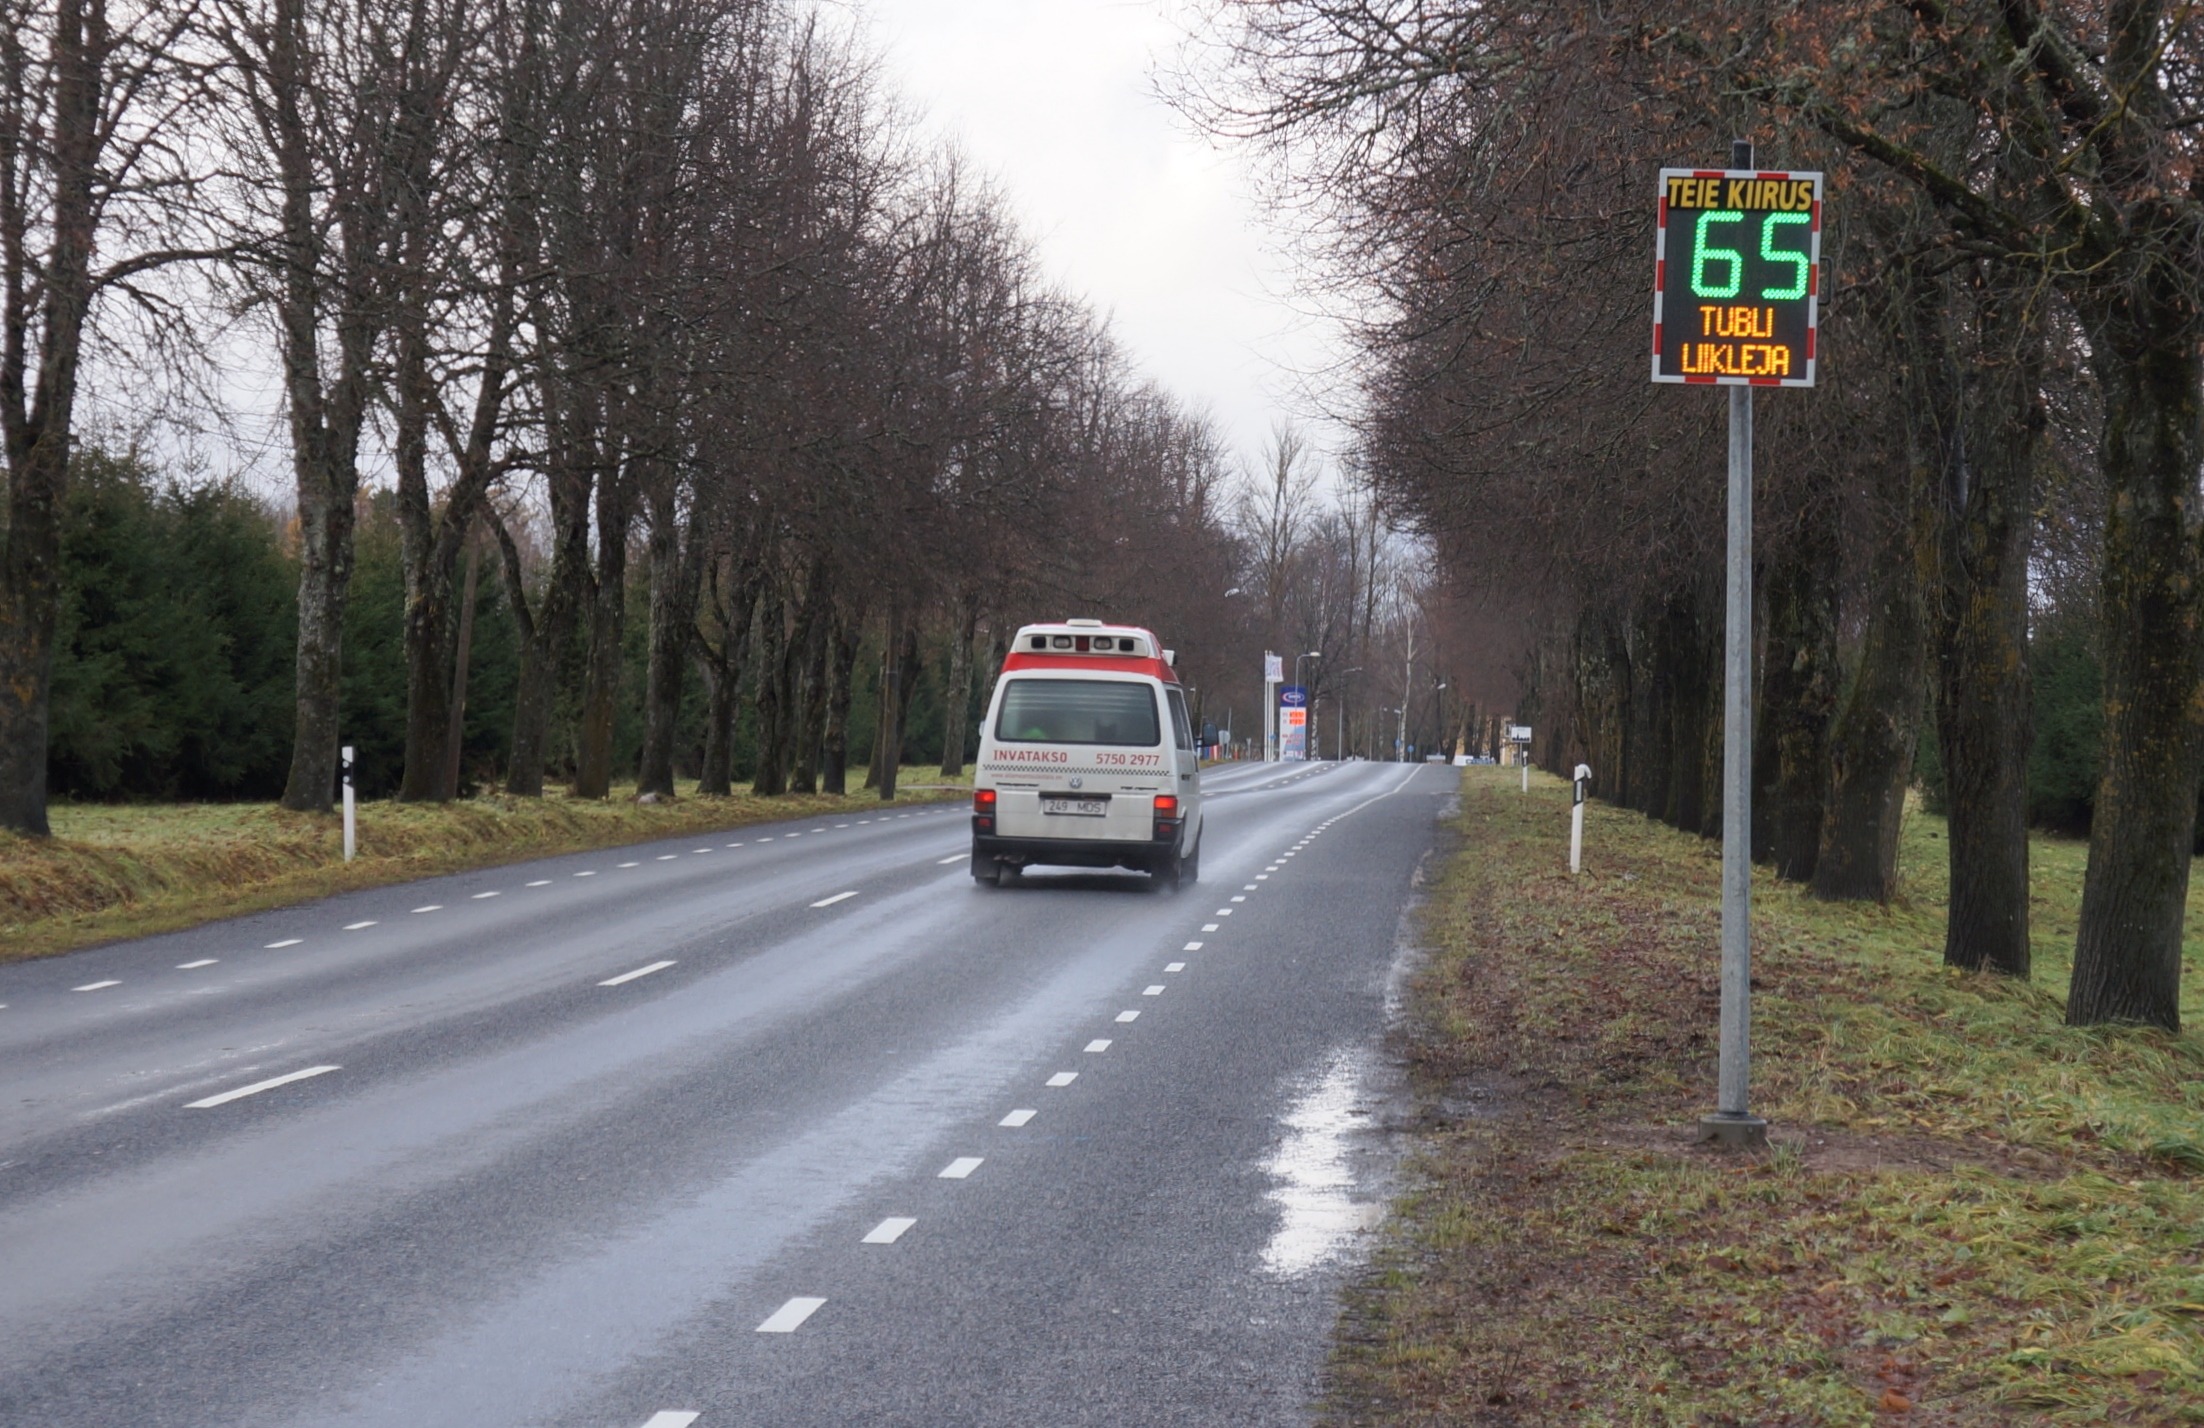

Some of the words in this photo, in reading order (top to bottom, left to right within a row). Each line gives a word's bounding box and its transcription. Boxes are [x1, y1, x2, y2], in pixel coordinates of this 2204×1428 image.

[1668, 178, 1720, 208] TEIE
[1727, 180, 1812, 210] KIIRUS
[1691, 211, 1810, 300] 65
[1699, 306, 1773, 337] TUBLI
[1682, 343, 1790, 375] LIIKLEJA
[993, 750, 1068, 763] INVATAKSO
[1096, 753, 1126, 764] 5750
[1129, 754, 1160, 766] 2977
